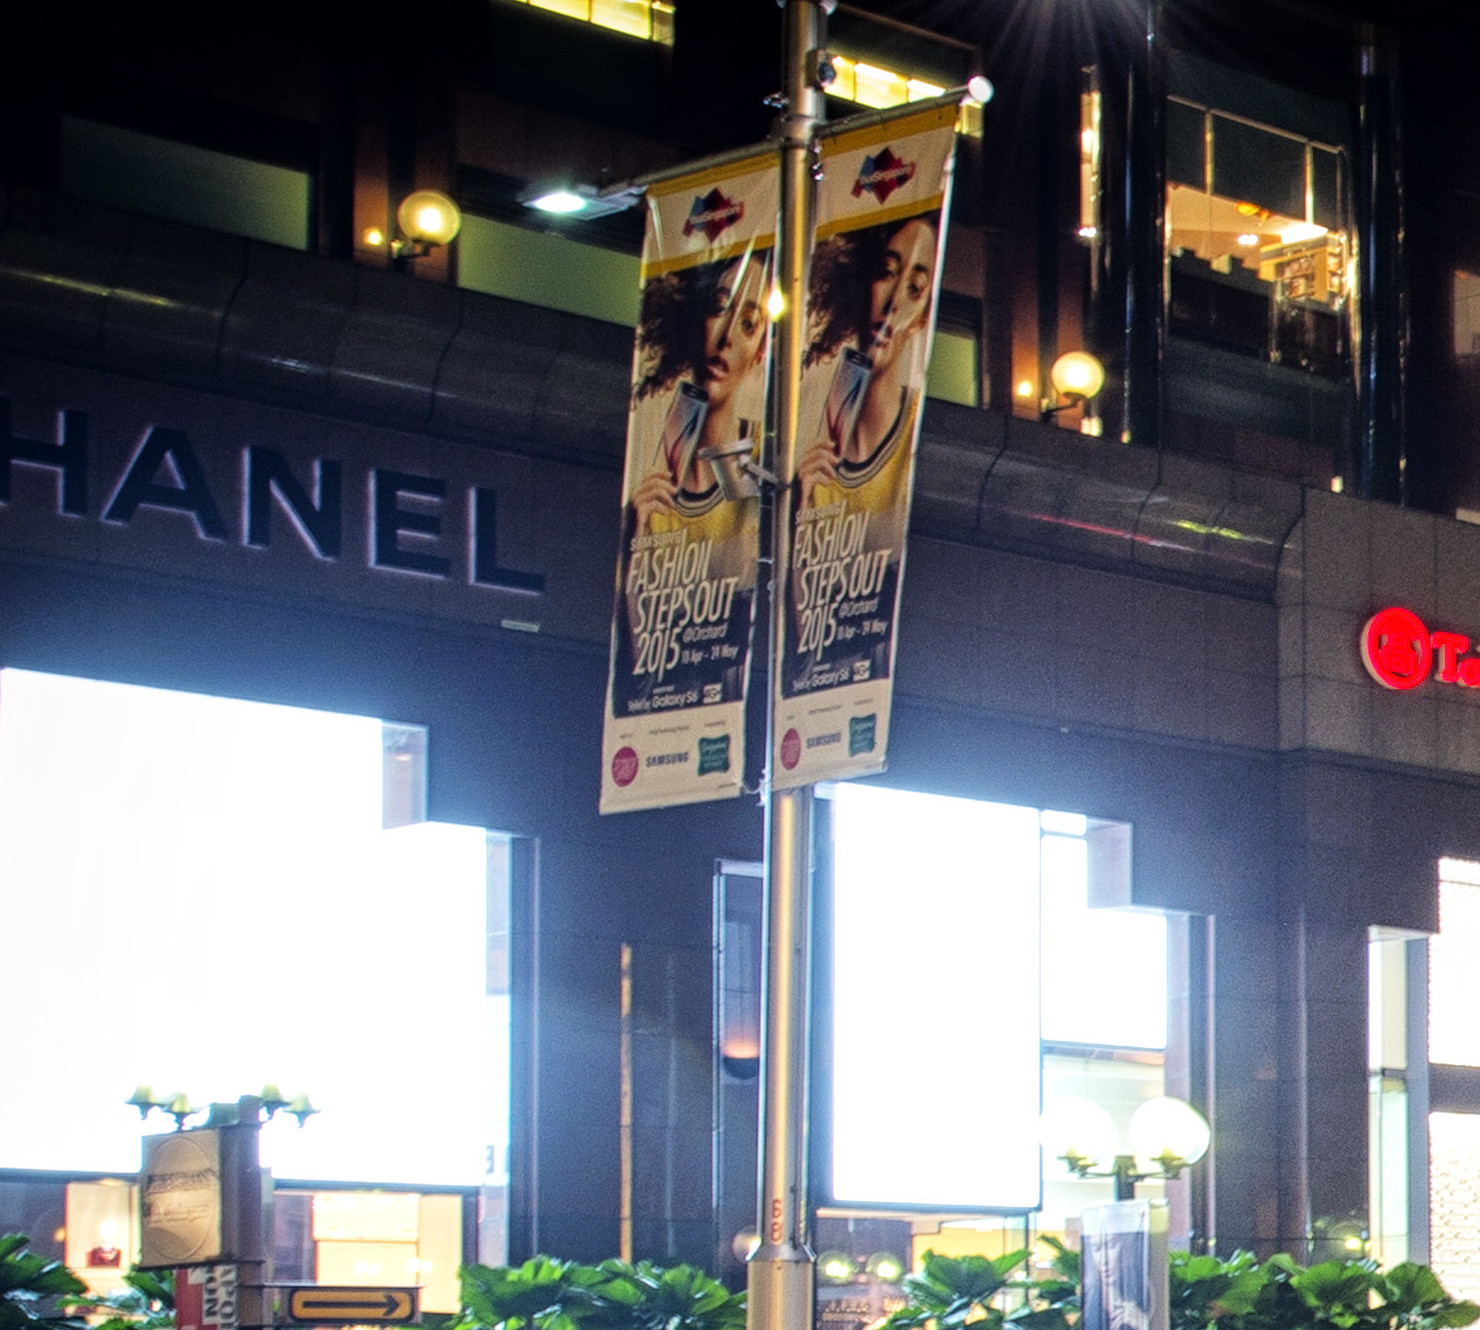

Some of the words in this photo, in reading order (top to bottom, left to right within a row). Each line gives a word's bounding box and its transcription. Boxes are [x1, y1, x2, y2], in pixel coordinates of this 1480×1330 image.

[625, 528, 713, 595] FASHION
[793, 499, 871, 569] FASHION
[632, 627, 682, 683] 2015
[797, 603, 839, 662] 2015
[646, 751, 690, 768] SAMSUNG
